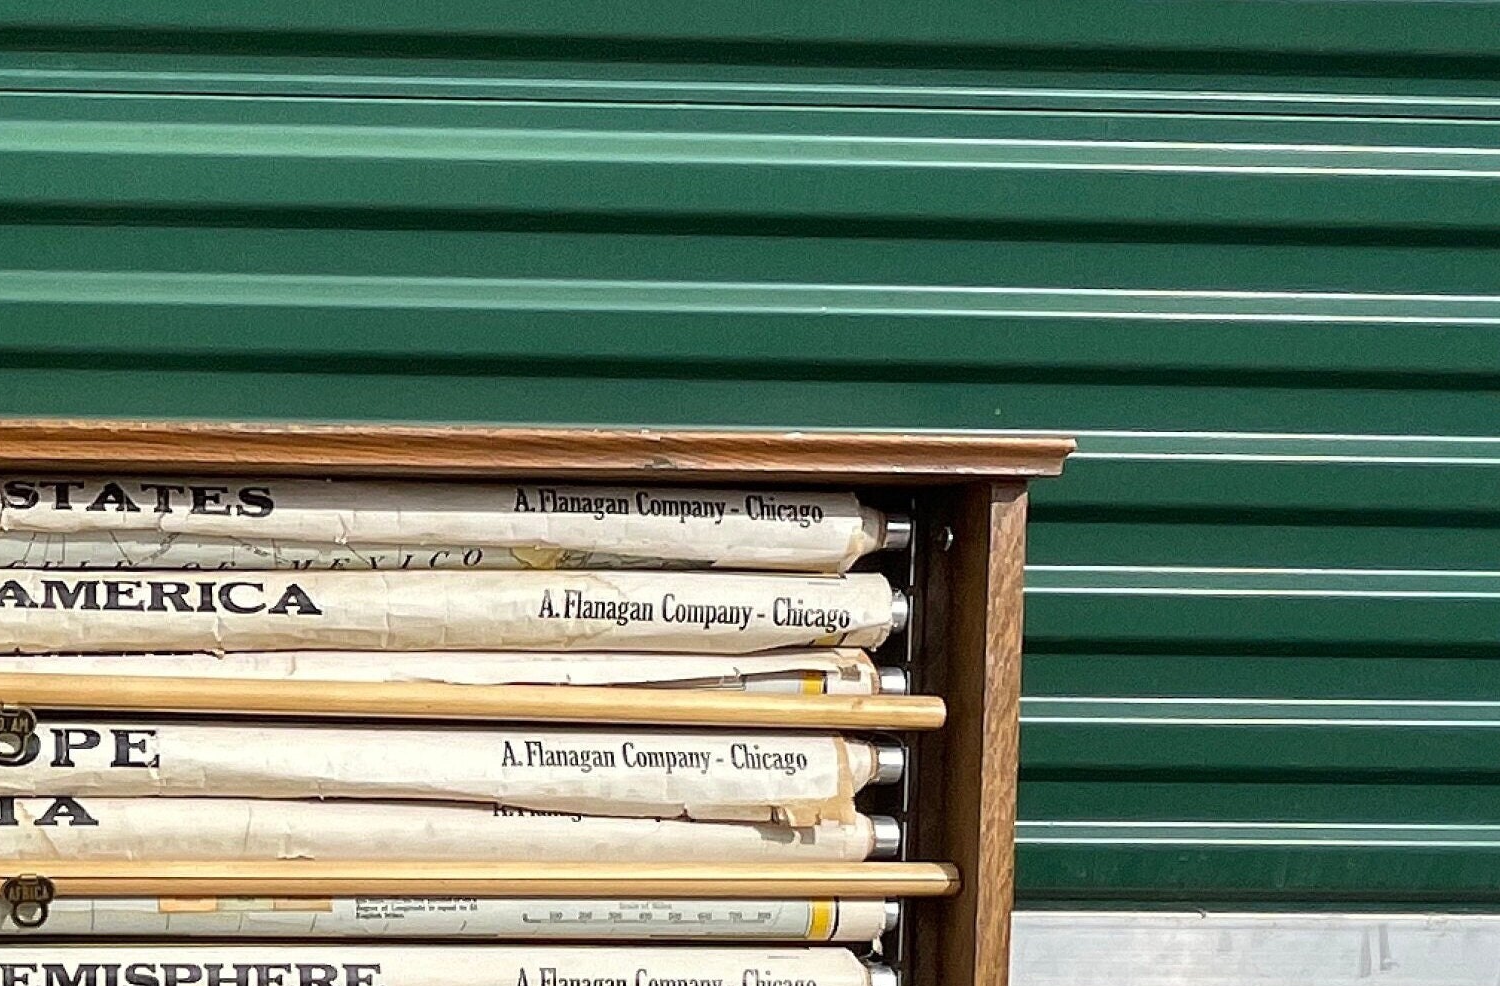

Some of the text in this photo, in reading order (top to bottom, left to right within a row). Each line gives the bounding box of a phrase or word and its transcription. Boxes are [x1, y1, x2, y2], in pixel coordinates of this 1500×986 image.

[1, 479, 276, 519] STATES
[513, 489, 536, 513] A.
[538, 490, 630, 521] Flanagan
[635, 492, 727, 526] Company
[744, 495, 825, 526] Chicago
[537, 589, 561, 619] A.
[563, 589, 654, 627] Flanagan
[661, 593, 753, 632] Company
[772, 596, 852, 634] Chicago
[501, 741, 523, 768] A.
[524, 741, 616, 774] Flanagan
[622, 742, 711, 775] Company
[730, 743, 808, 777] Chicago
